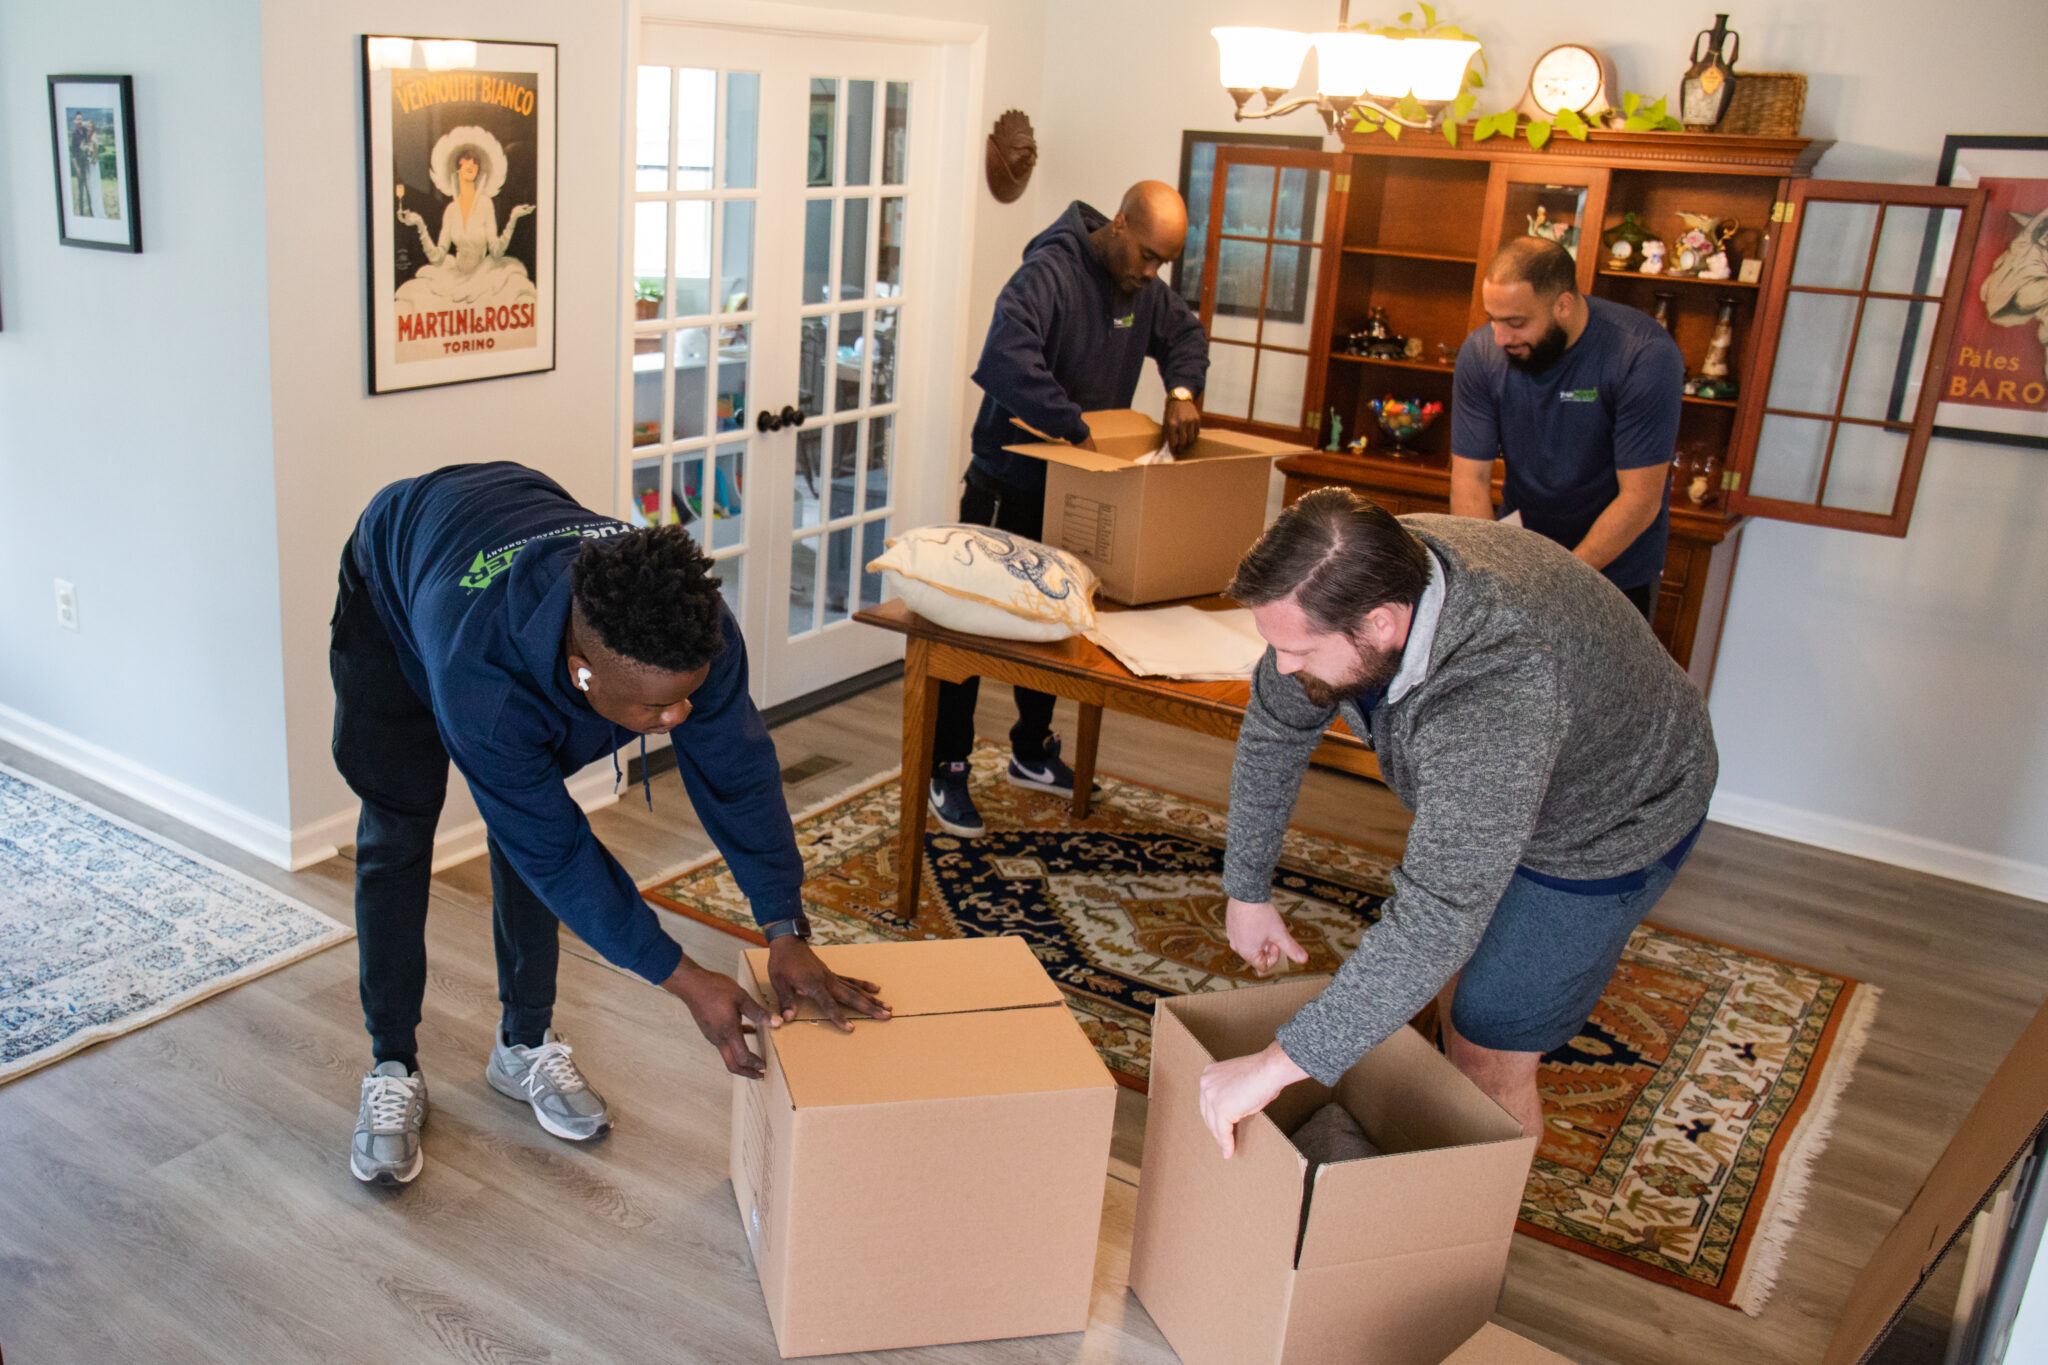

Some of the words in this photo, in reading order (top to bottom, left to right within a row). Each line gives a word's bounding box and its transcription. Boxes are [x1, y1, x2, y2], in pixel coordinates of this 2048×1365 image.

[395, 74, 477, 114] VERMOUTH
[481, 75, 534, 117] BIANCO
[443, 338, 496, 354] TORINO
[1949, 375, 2046, 404] BARO
[486, 538, 528, 559] COMPANY
